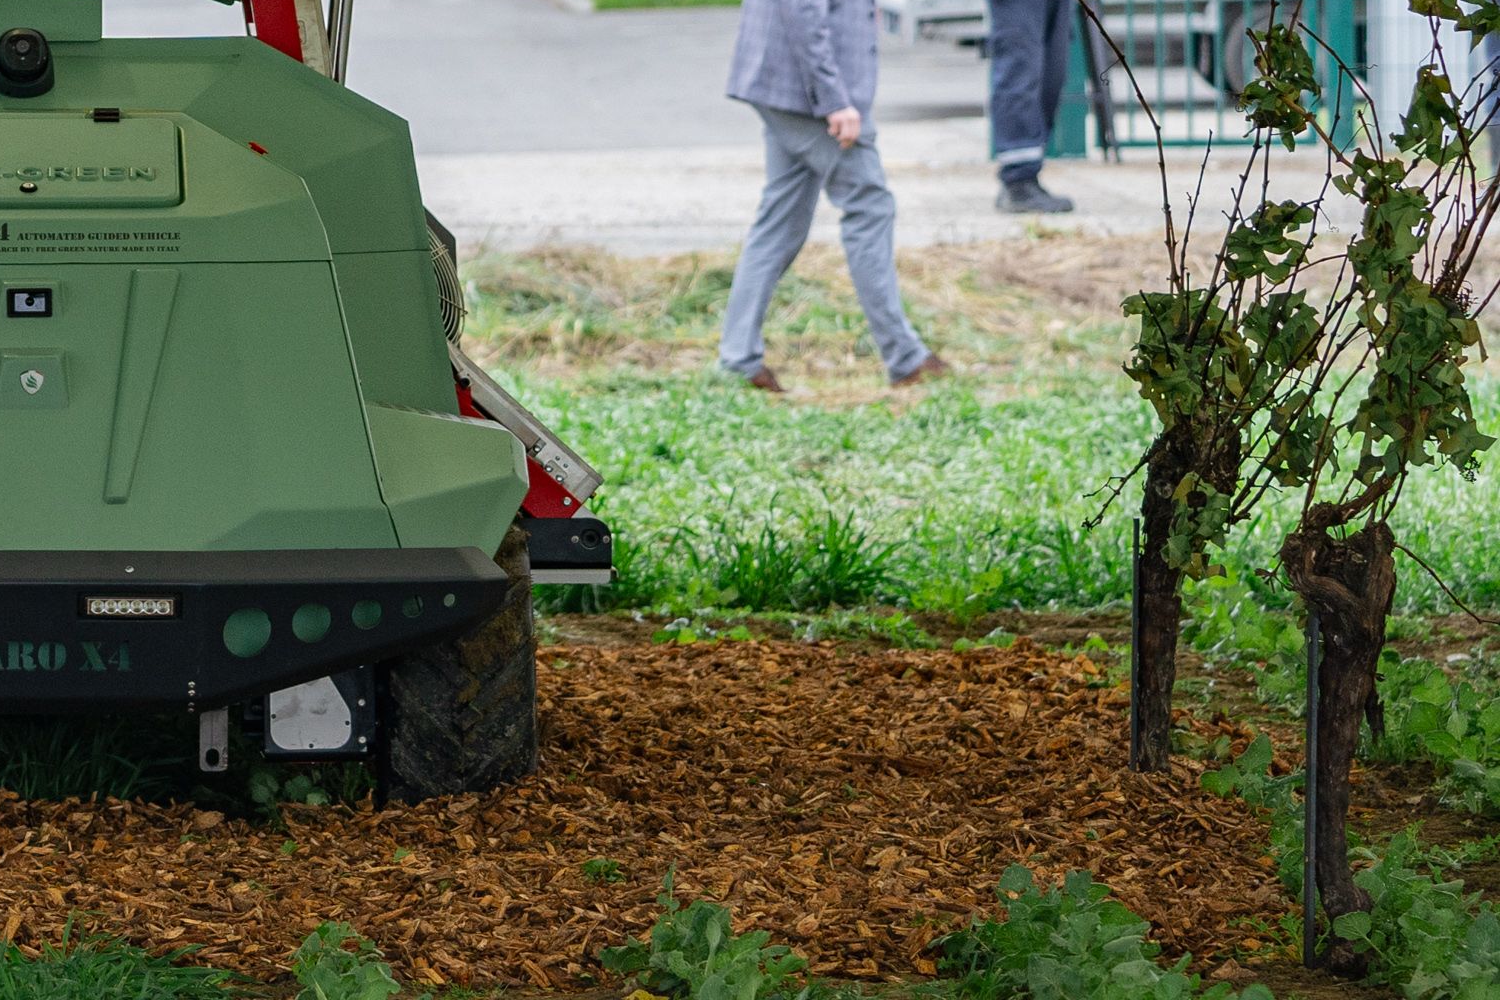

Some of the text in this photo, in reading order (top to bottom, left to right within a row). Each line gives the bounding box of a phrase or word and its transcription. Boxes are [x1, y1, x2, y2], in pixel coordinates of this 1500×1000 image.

[17, 233, 85, 241] AUTOMATED
[88, 232, 130, 240] GUIDED
[133, 232, 181, 240] VEHICLE
[79, 640, 132, 671] X4
